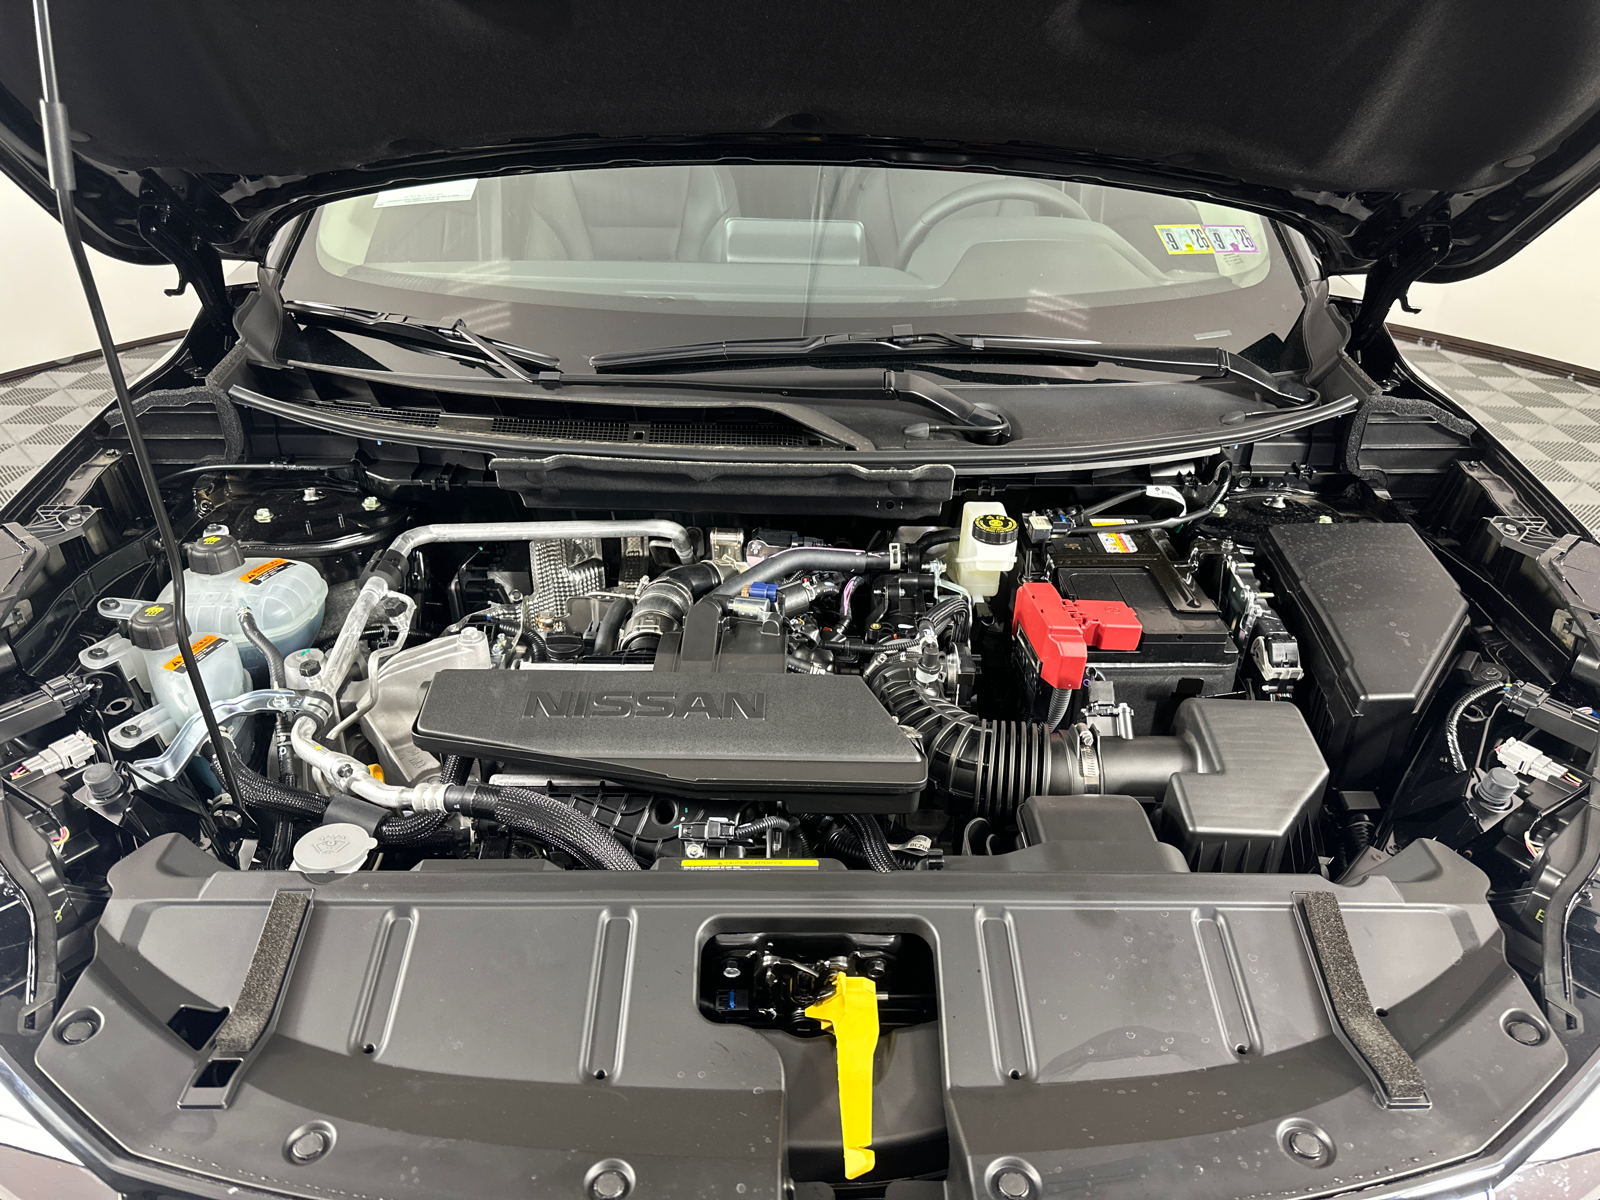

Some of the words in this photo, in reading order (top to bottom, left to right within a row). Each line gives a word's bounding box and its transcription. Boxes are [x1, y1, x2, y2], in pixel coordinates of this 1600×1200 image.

[1166, 232, 1179, 250] 9
[1190, 228, 1210, 248] 26
[1212, 232, 1226, 250] 9
[1235, 228, 1255, 248] 26
[522, 691, 767, 719] NISSAN
